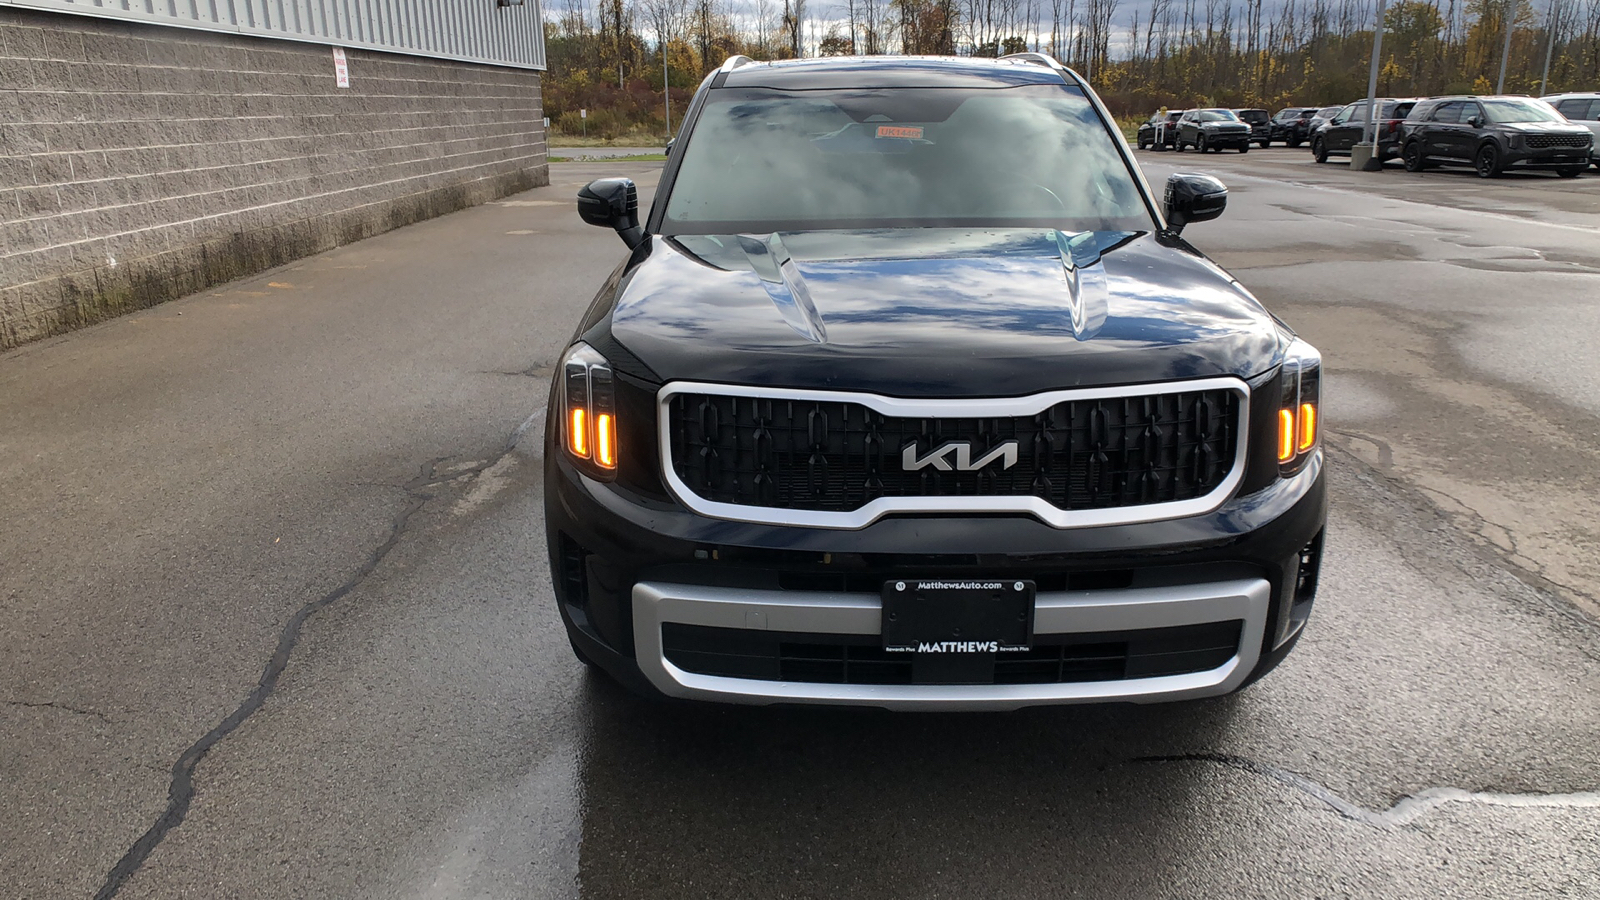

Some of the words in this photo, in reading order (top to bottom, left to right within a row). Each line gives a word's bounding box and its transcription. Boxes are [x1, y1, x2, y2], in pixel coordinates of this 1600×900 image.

[902, 442, 1018, 471] KIA
[918, 581, 1002, 589] MatthewsAuto.com
[917, 641, 998, 653] MATTHEWS
